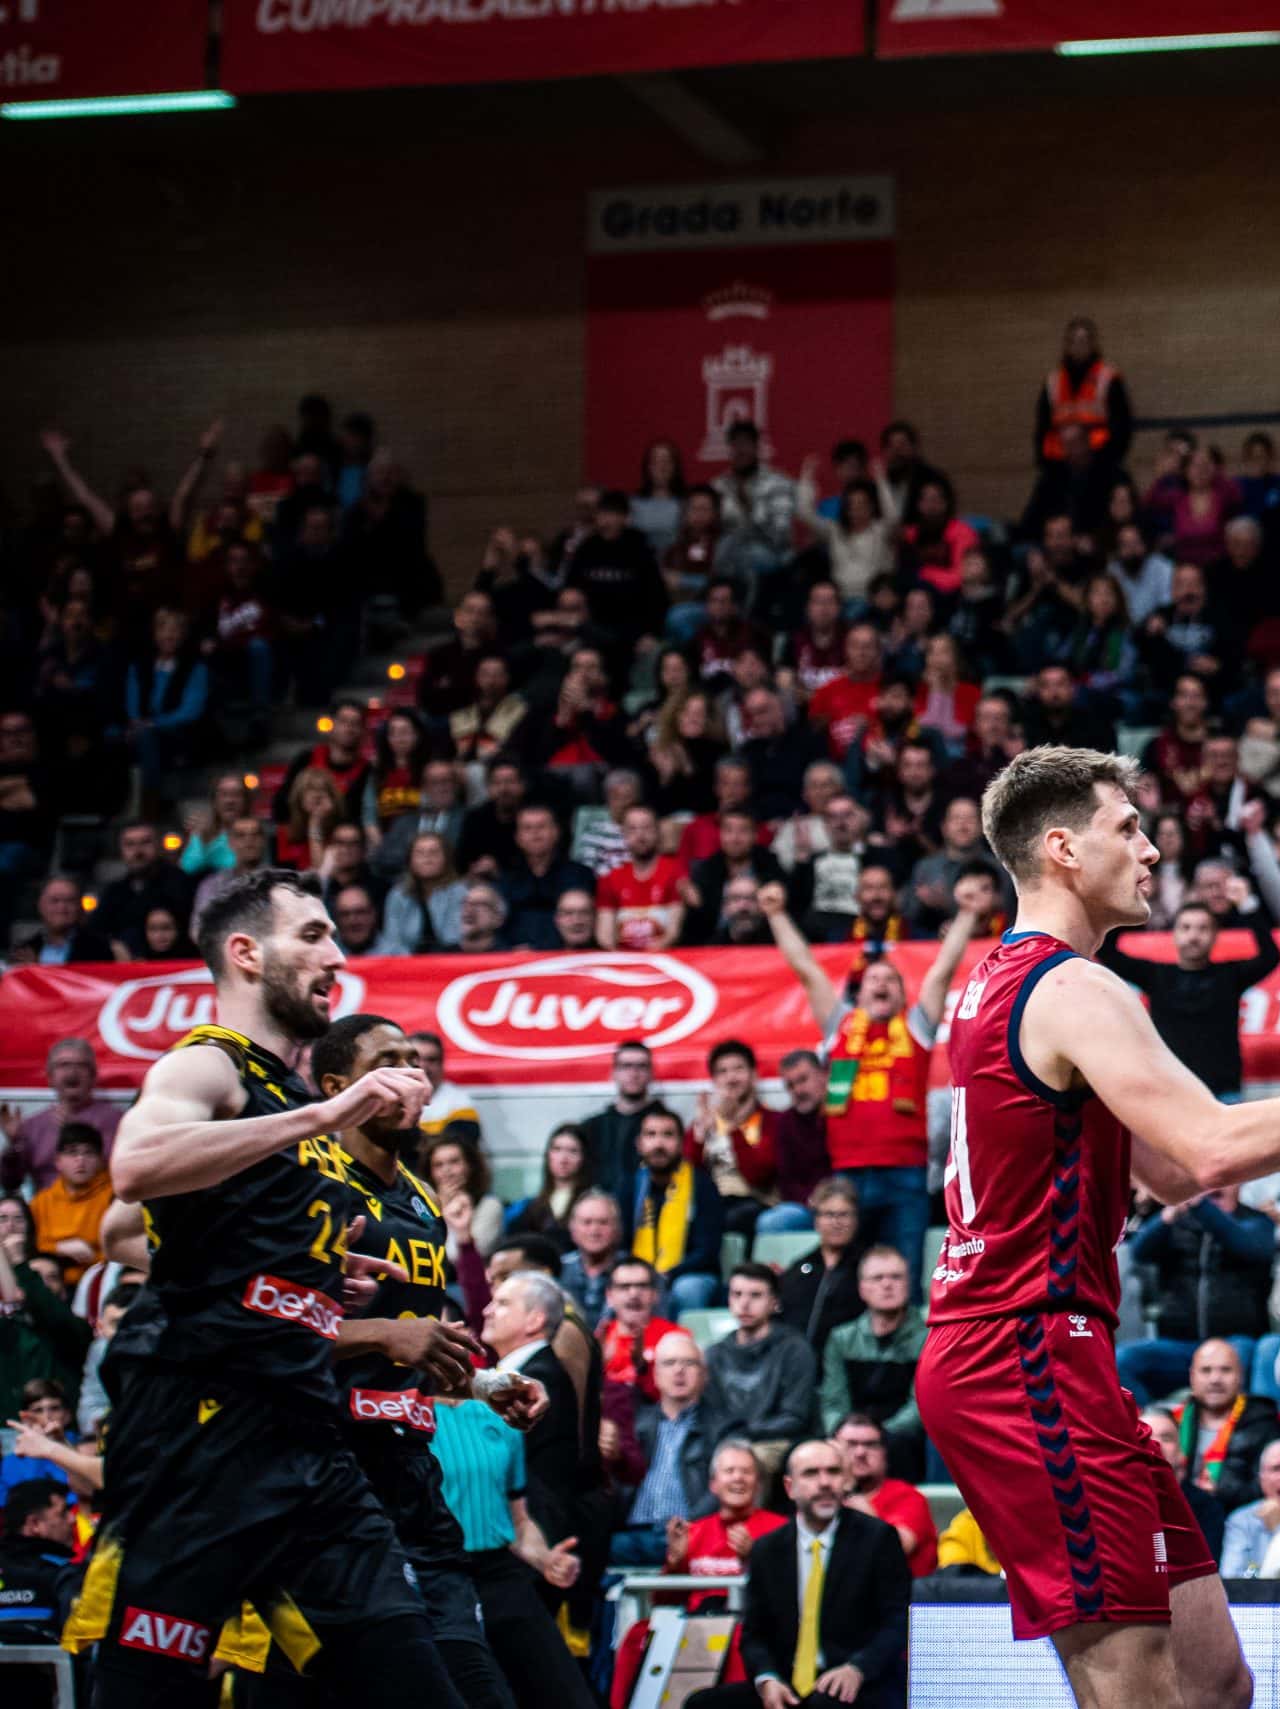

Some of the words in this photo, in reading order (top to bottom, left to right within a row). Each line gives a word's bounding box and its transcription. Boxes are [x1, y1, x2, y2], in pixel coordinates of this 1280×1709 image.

[601, 198, 742, 238] Grada
[760, 190, 881, 229] Norte
[467, 980, 685, 1031] Juver
[377, 1236, 447, 1291] AEK
[122, 1613, 210, 1658] AVIS
